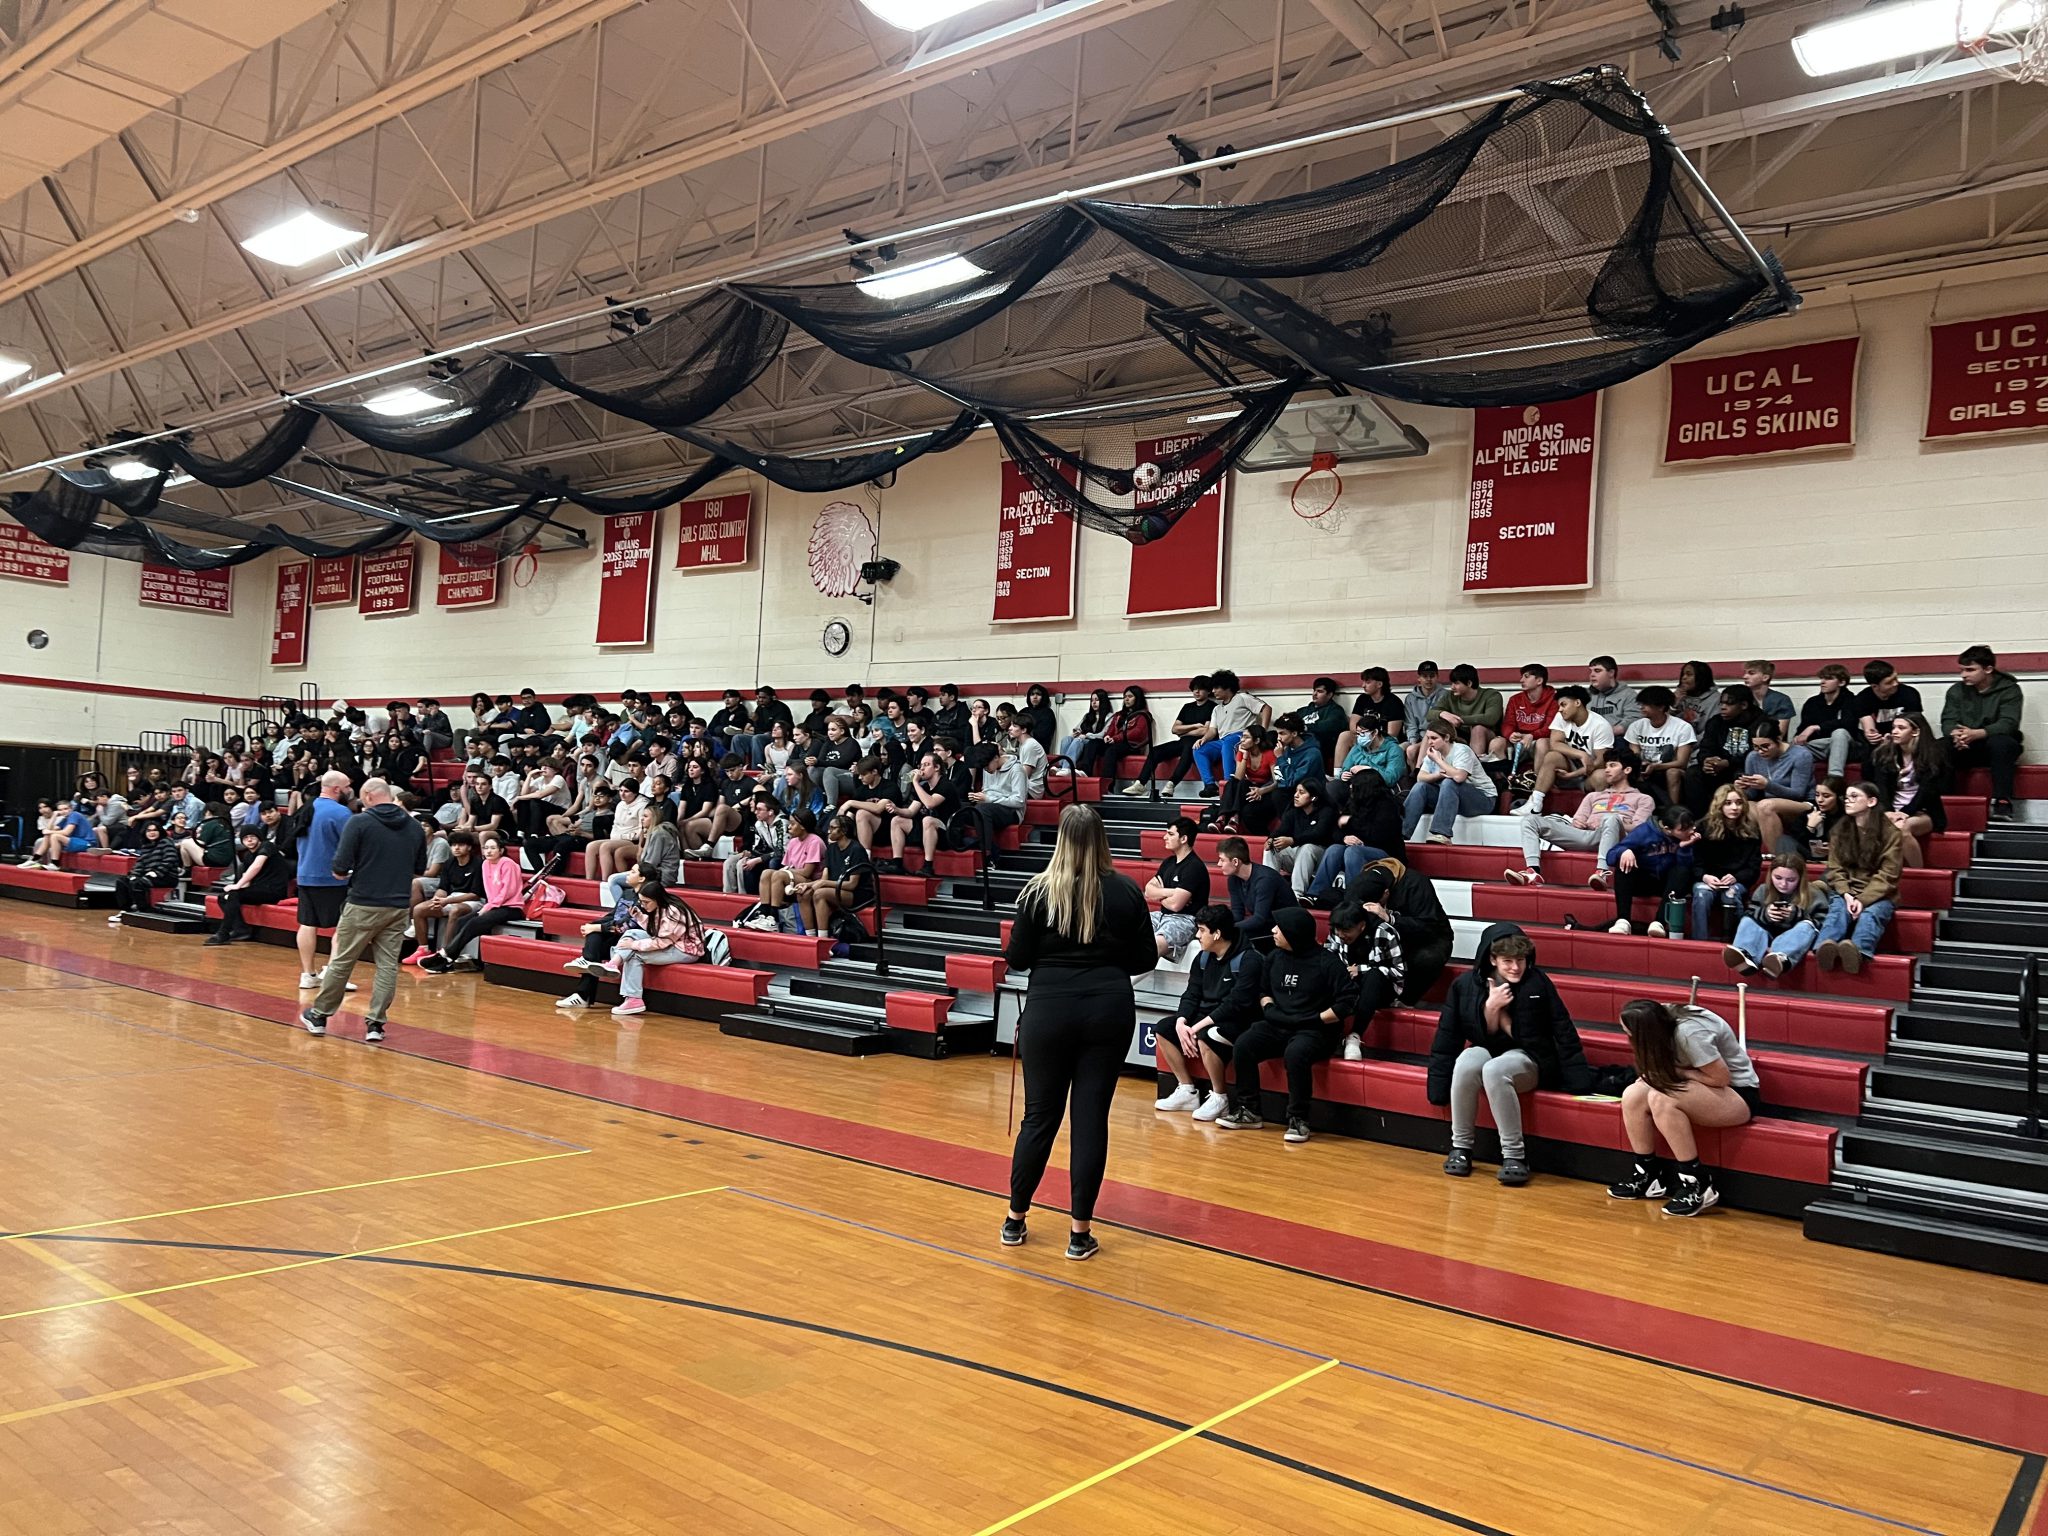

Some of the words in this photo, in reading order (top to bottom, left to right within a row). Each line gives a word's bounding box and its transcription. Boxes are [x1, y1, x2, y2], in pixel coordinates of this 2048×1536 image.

[1976, 324, 2048, 352] UC
[1707, 364, 1813, 395] UCAL
[1724, 394, 1794, 412] 1974
[1949, 400, 2026, 421] GIRLS
[1679, 418, 1747, 443] GIRLS
[1756, 408, 1839, 435] SKIING
[1503, 423, 1564, 446] INDIANS
[1475, 443, 1529, 465] ALPINE
[1539, 437, 1592, 456] SKIING
[1504, 458, 1558, 476] LEAGUE
[1162, 468, 1200, 486] DIANS
[1472, 479, 1494, 490] 1968
[1472, 489, 1493, 500] 1974
[705, 500, 723, 519] 1981
[1471, 499, 1492, 509] 1975
[1003, 503, 1033, 520] TRACK
[1035, 503, 1041, 514] &
[1471, 508, 1492, 519] 1995
[614, 515, 642, 528] LIBERTY
[1019, 514, 1054, 527] LEAGUE
[699, 523, 717, 540] CROSS
[719, 519, 745, 539] COUNTRY
[1499, 522, 1555, 540] SECTION
[701, 544, 721, 562] MHAL
[1468, 542, 1489, 552] 1975
[603, 551, 622, 563] CROSS
[1467, 552, 1489, 562] 1989
[321, 562, 344, 574] UCAL
[365, 560, 408, 573] UNDEFEATED
[1016, 566, 1050, 579] SECTION
[1466, 562, 1488, 572] 1994
[368, 573, 403, 585] FOOTBALL
[1465, 571, 1487, 581] 1995
[317, 583, 346, 595] FOOTBALL
[365, 585, 405, 597] CHAMPIONS
